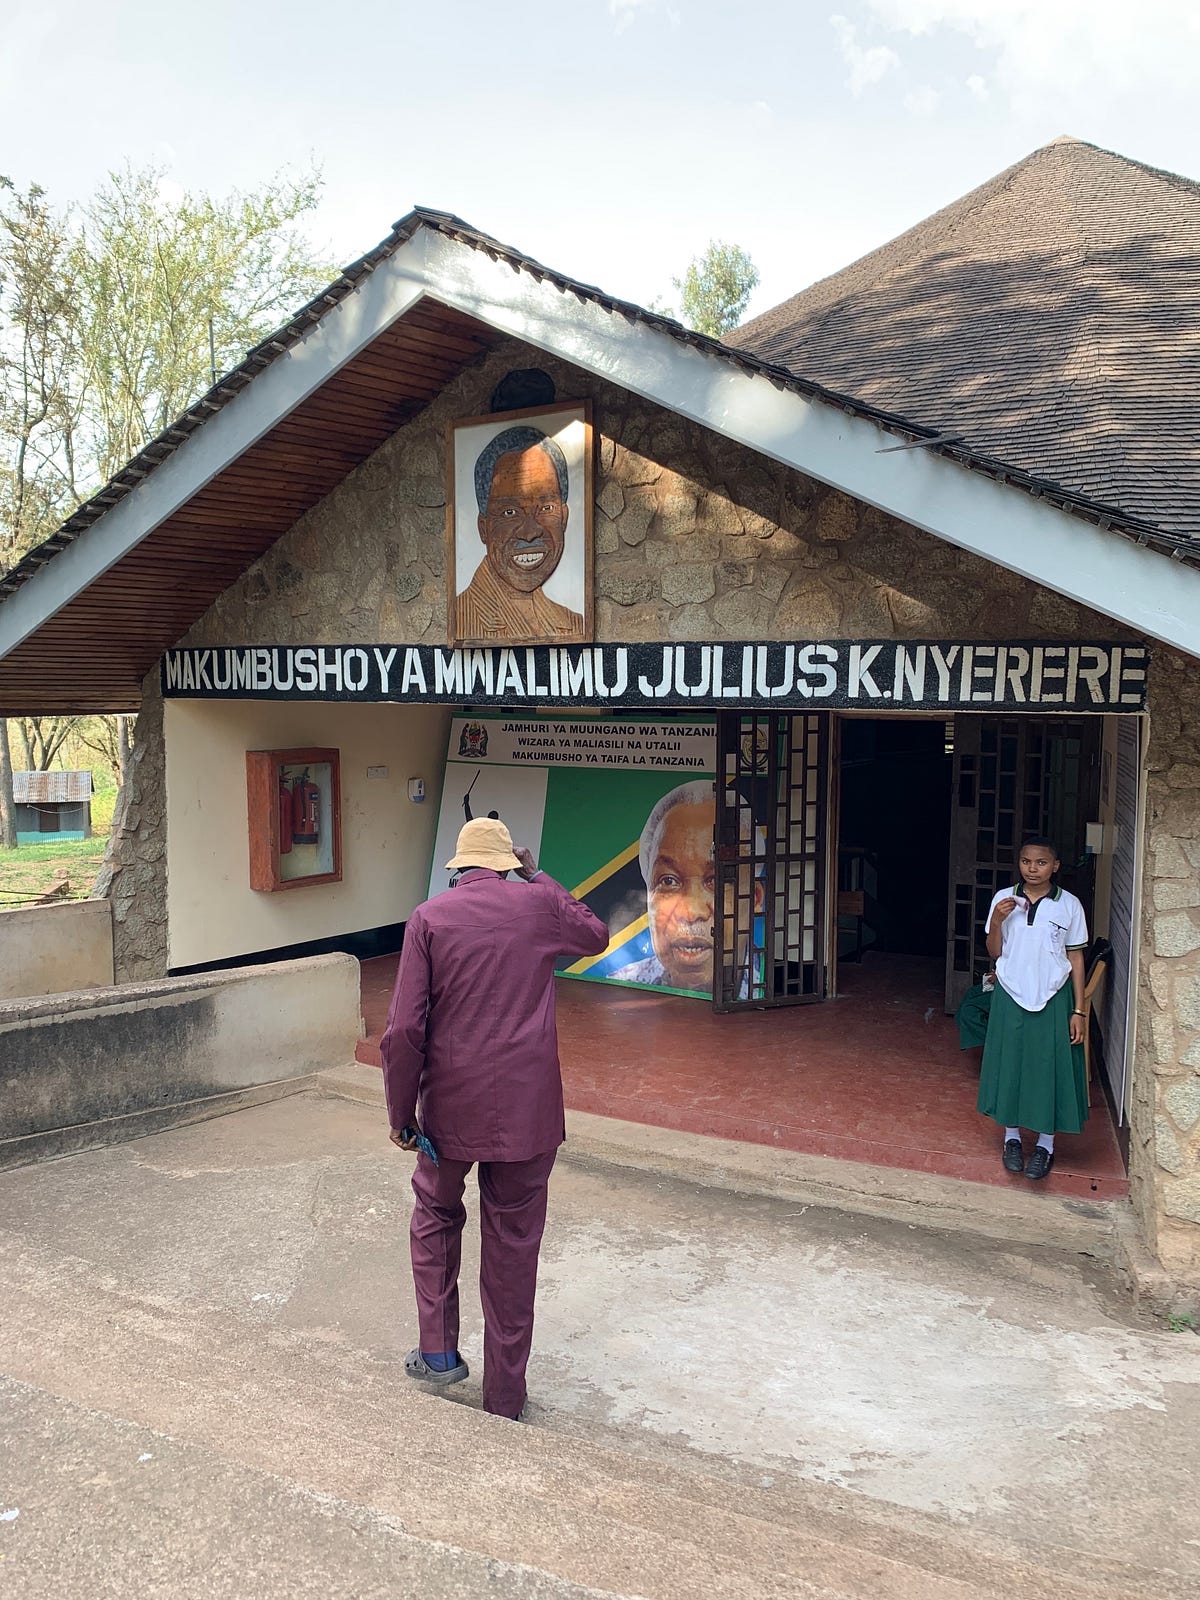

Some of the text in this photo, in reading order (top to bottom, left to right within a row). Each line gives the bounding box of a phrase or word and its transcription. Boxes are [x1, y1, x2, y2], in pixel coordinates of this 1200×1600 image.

[166, 648, 369, 692] MAKUMBUSHO
[374, 648, 427, 693] YA
[434, 648, 628, 697] MWALIMU
[638, 644, 838, 699] JULIUS
[501, 723, 549, 733] JAMHURI
[553, 724, 566, 733] YA
[569, 725, 635, 735] MUUNGANO
[639, 726, 657, 735] WA
[518, 737, 681, 750] WIZARA YA MALIASILI NA UTALII
[512, 751, 705, 767] MAKUMBUSHO YA TAIFA LA TANZANIA
